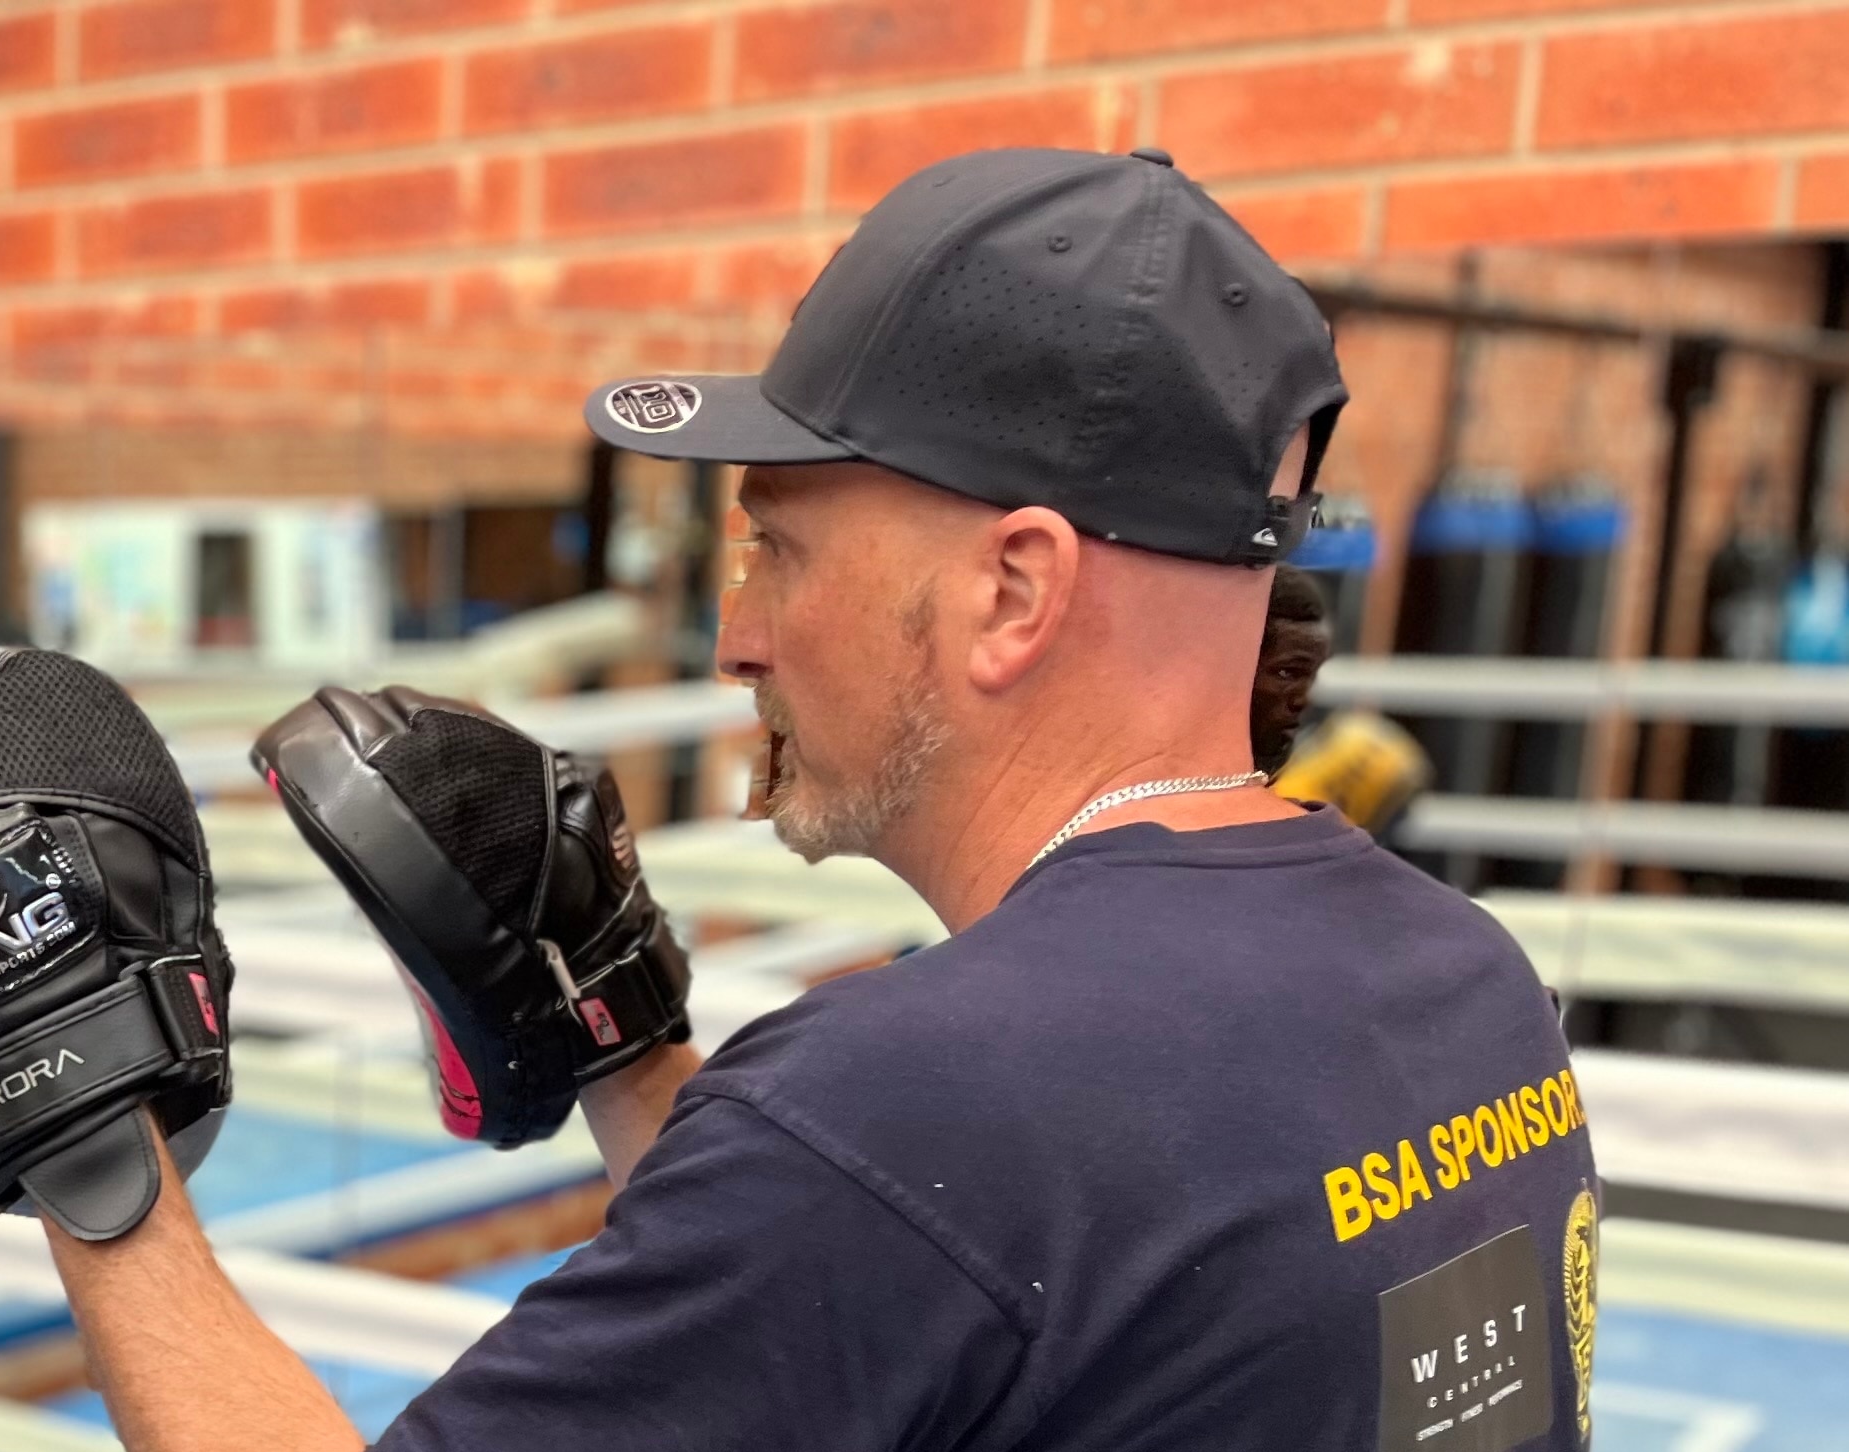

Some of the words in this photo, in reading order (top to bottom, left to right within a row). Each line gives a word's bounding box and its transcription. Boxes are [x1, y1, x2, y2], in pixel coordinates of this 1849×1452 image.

[1323, 1139, 1433, 1242] BSA
[1429, 1069, 1585, 1189] SPONSOR
[1410, 1304, 1526, 1383] WEST
[1427, 1355, 1516, 1408] CENTRAL
